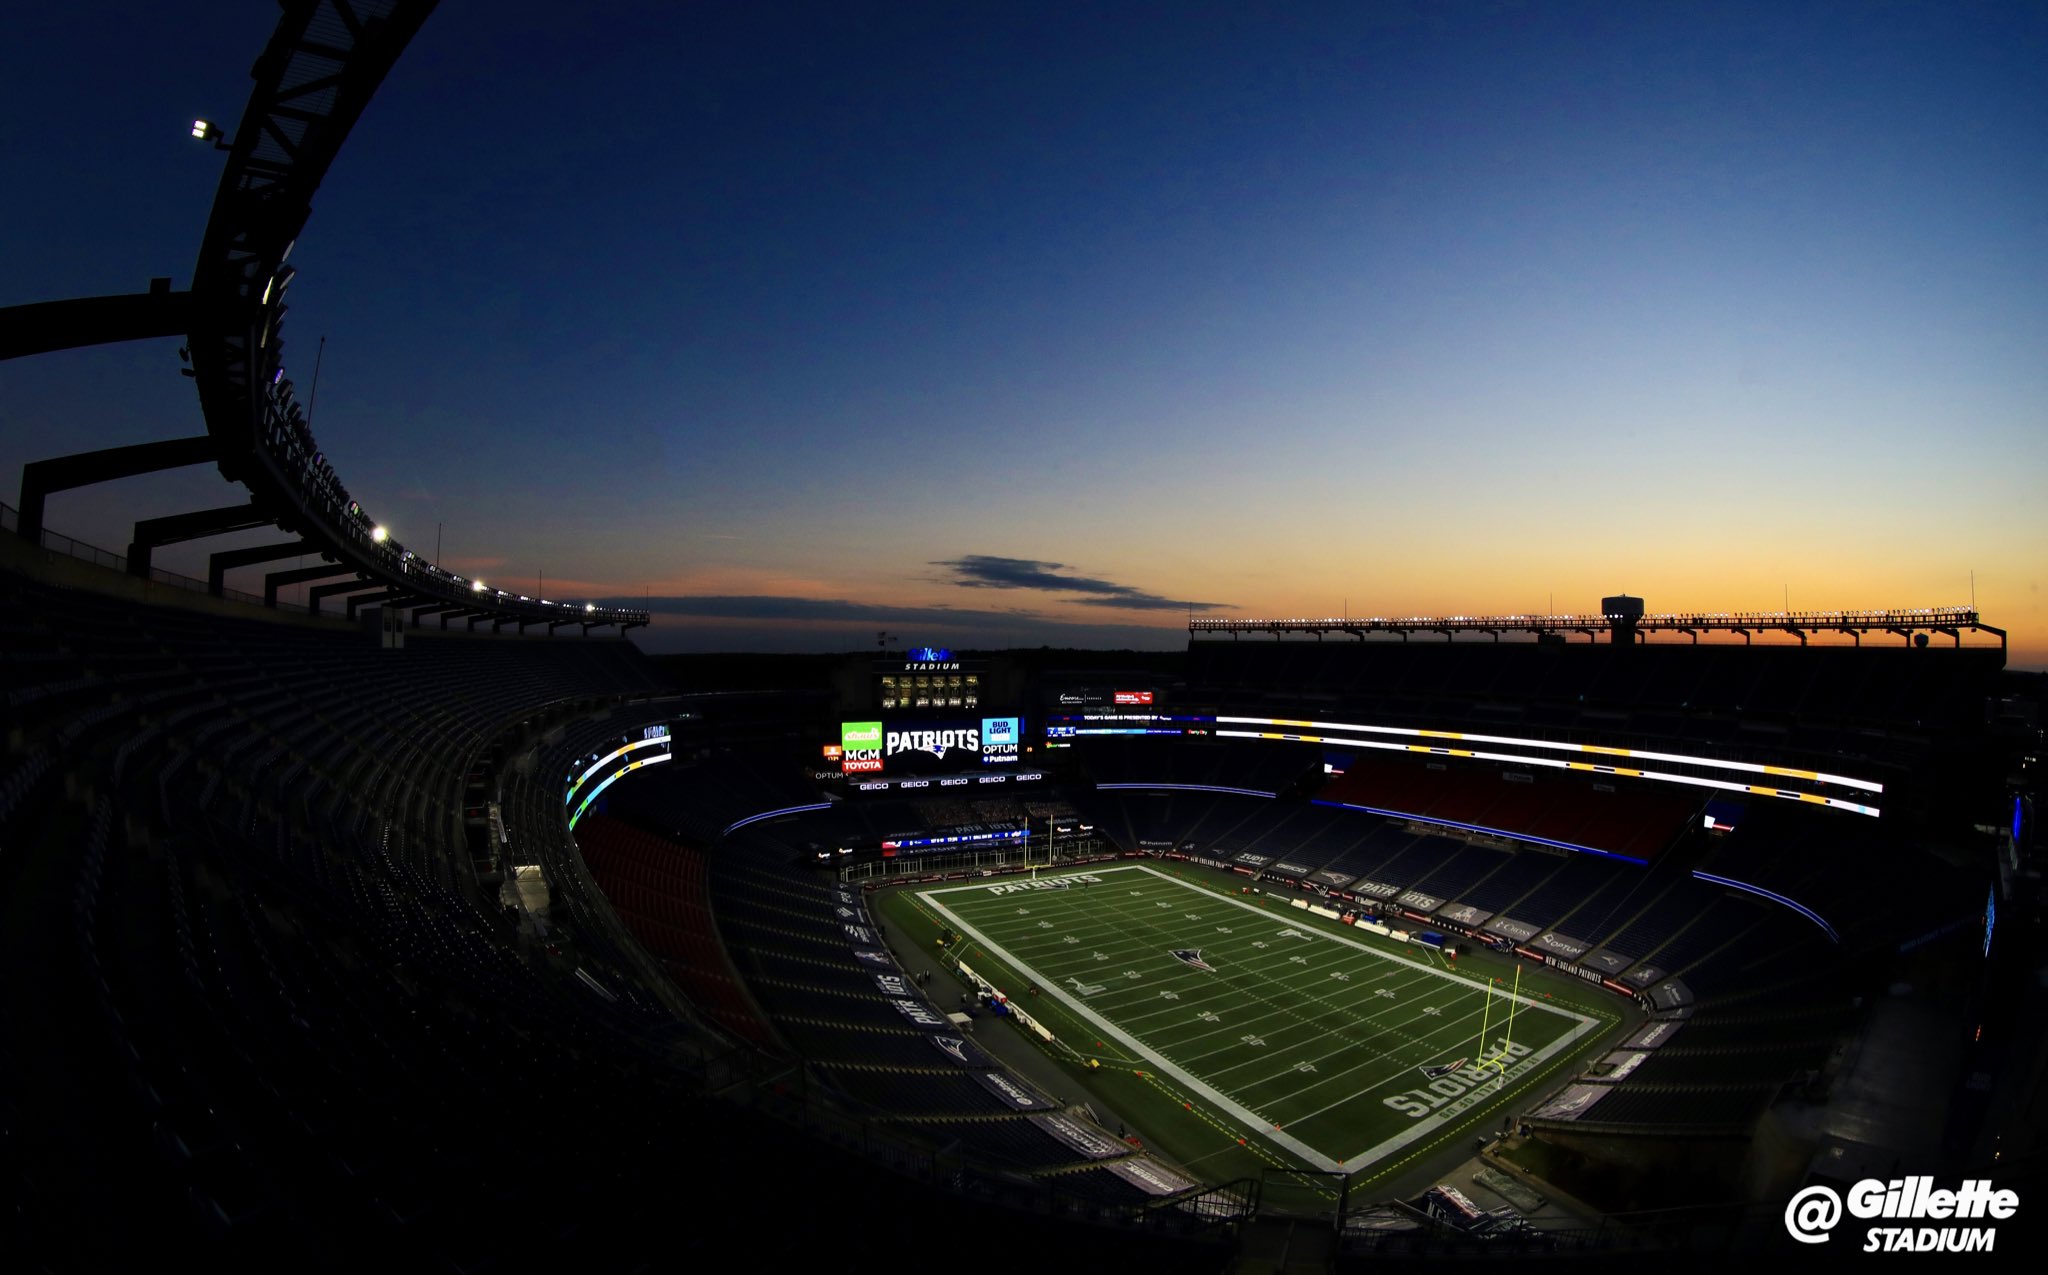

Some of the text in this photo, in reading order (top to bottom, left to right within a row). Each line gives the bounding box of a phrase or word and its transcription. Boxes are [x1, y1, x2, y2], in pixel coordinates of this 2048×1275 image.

[905, 663, 960, 671] STADIUM
[989, 727, 1011, 735] LIGHT
[886, 729, 980, 757] PATRIOTS
[983, 744, 1018, 755] OPTUM
[845, 749, 881, 761] MGM
[989, 755, 1018, 763] Putnam
[844, 761, 881, 771] TOYOTA
[815, 772, 844, 780] OPTUM
[979, 776, 1006, 784] GEICO
[1016, 773, 1042, 781] GEICO
[901, 780, 929, 788] GEICO
[940, 778, 968, 786] GEICO
[860, 783, 889, 791] GEICO
[1276, 863, 1308, 874] GEICO
[987, 874, 1103, 896] PATRIOTS
[1579, 967, 1602, 984] PATRIOTS
[1382, 1037, 1533, 1118] PATRIOTS
